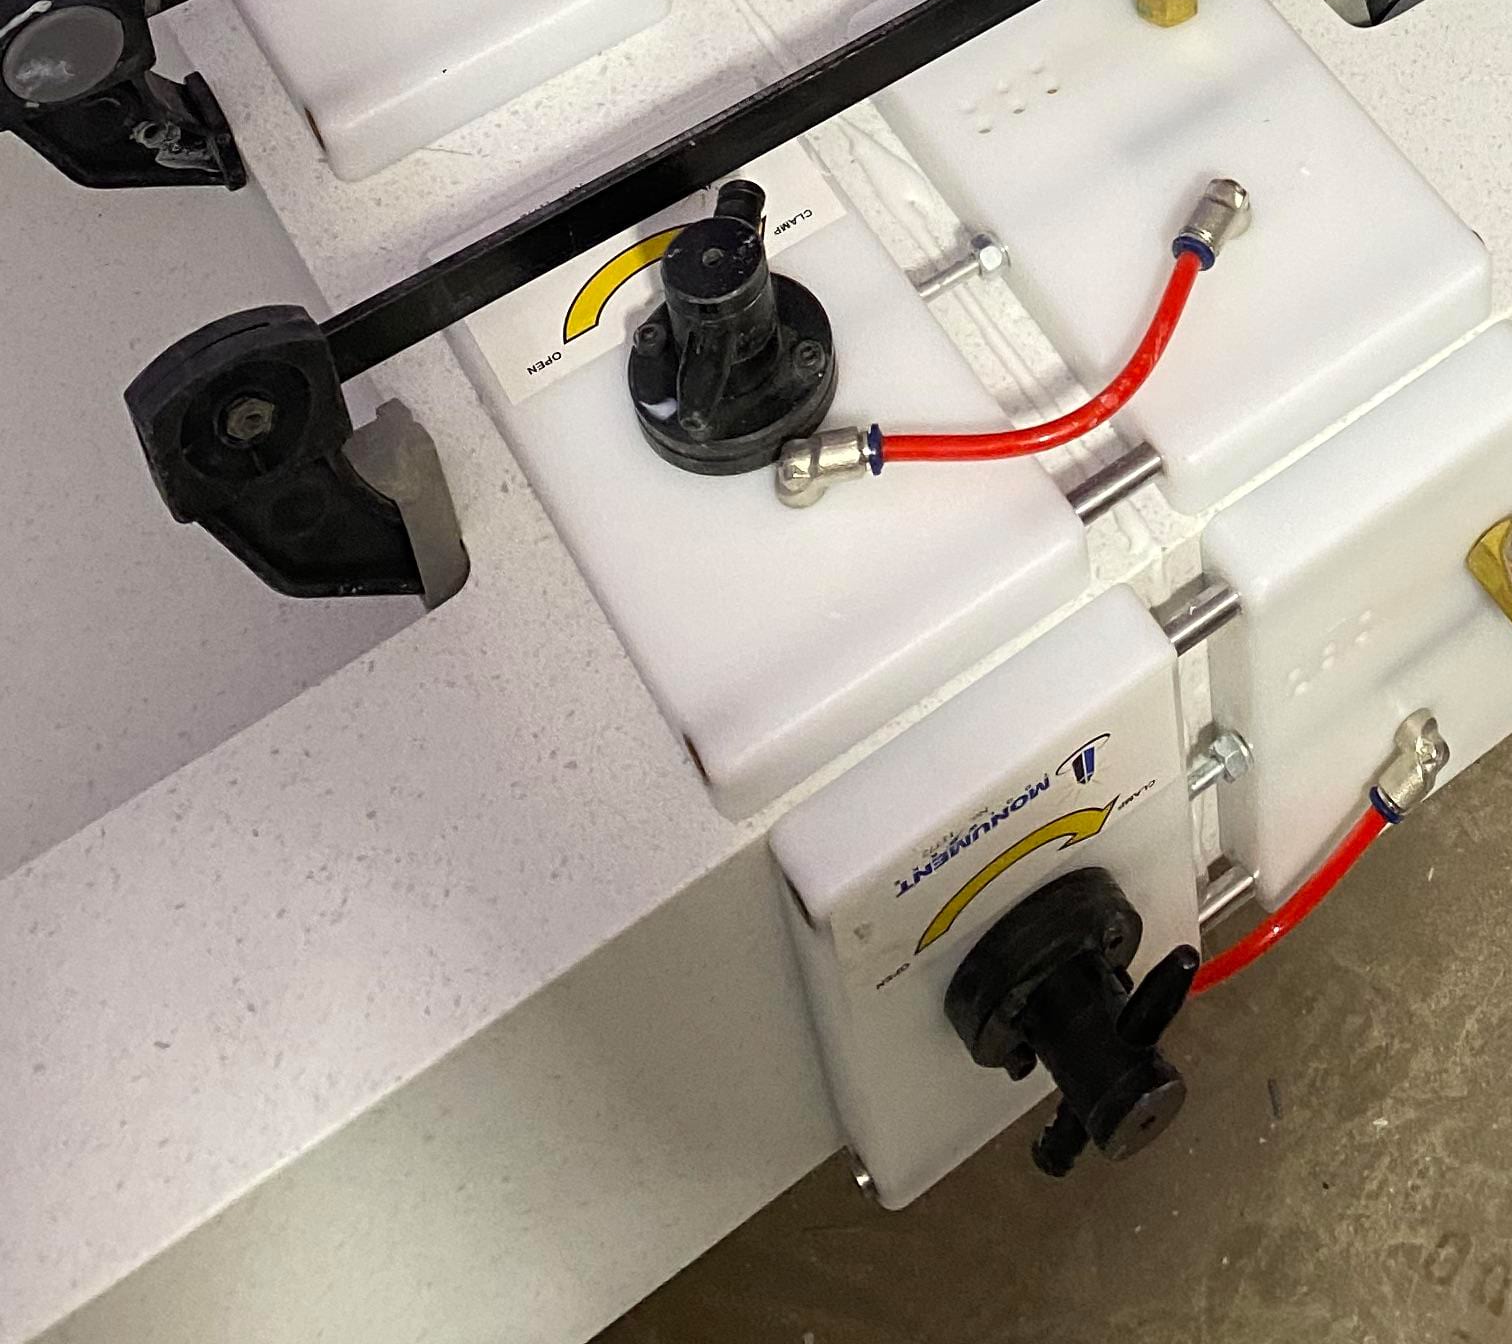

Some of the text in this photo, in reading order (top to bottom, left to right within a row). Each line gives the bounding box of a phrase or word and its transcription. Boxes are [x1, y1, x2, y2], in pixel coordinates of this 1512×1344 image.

[774, 208, 813, 237] CLAMP
[526, 351, 562, 376] OPEN
[1117, 778, 1158, 811] CLAMP
[896, 774, 1051, 898] MONUMENT
[876, 962, 910, 991] OPEN
